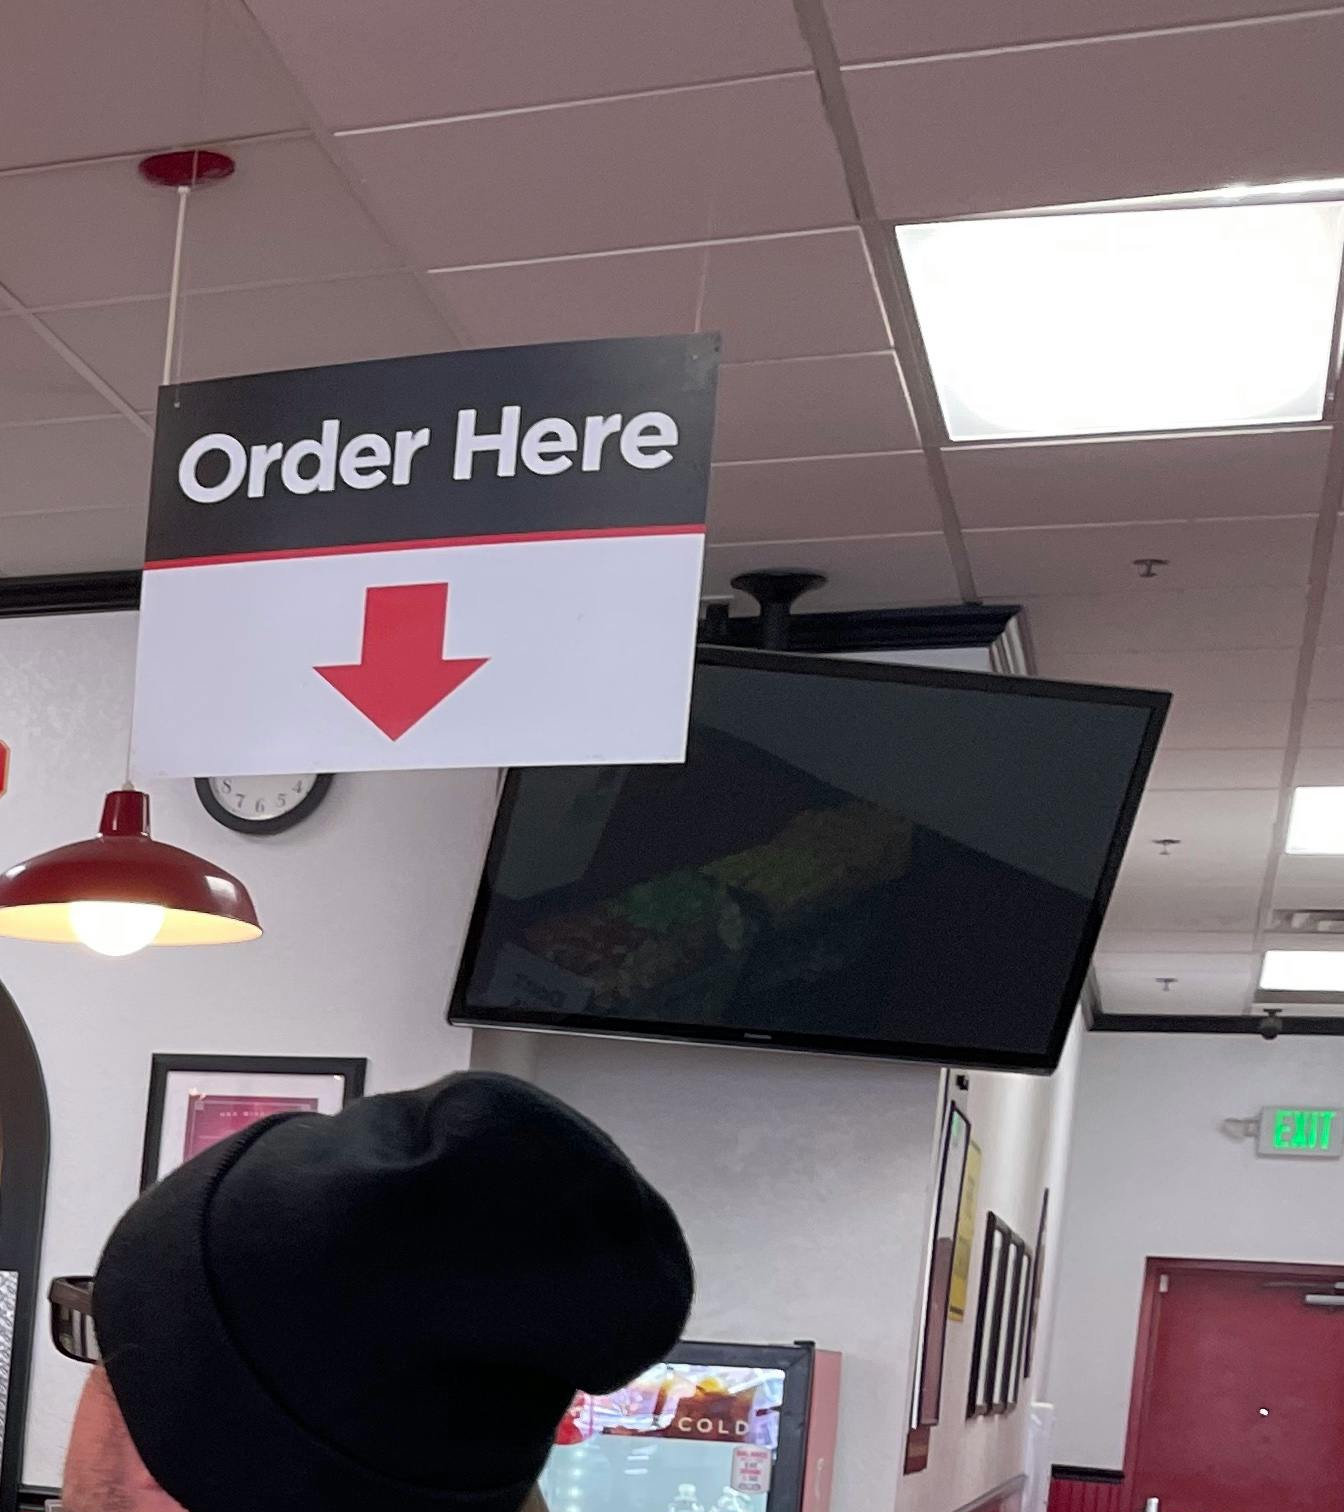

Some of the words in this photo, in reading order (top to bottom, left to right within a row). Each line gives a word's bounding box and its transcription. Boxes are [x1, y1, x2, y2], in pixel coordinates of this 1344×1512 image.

[177, 418, 431, 504] Order
[453, 404, 680, 481] Here
[1273, 1109, 1337, 1150] EXIT
[678, 1416, 750, 1437] COLD
